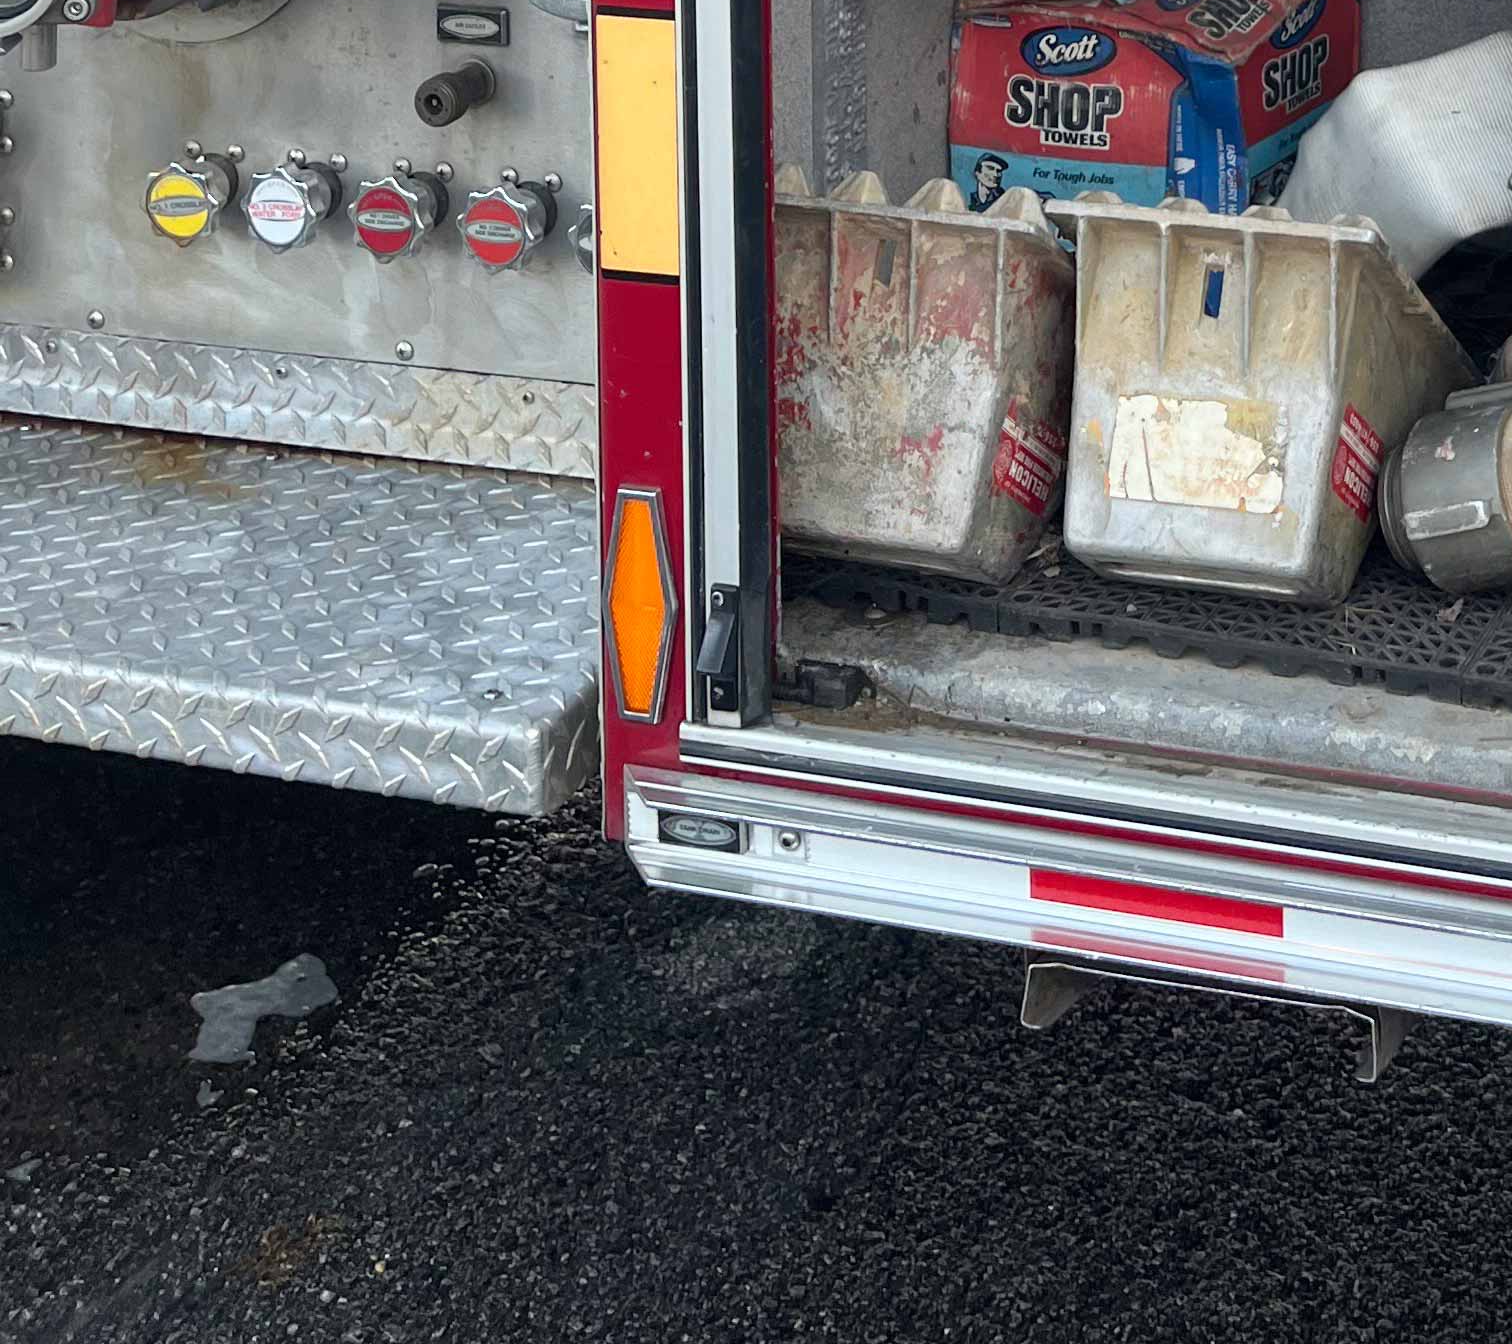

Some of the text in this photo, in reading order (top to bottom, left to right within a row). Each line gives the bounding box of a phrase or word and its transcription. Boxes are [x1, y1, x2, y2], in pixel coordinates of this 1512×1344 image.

[1237, 0, 1271, 35] TOWELS
[1036, 33, 1099, 67] Scott
[1264, 35, 1327, 109] SHOP
[1006, 76, 1122, 133] SHOP
[1287, 82, 1321, 111] TOWELS
[1043, 130, 1107, 147] TOWELS
[1033, 167, 1114, 187] For Tough Jobs
[1226, 144, 1238, 201] EASY CARRY
[1008, 459, 1051, 503] HELICON
